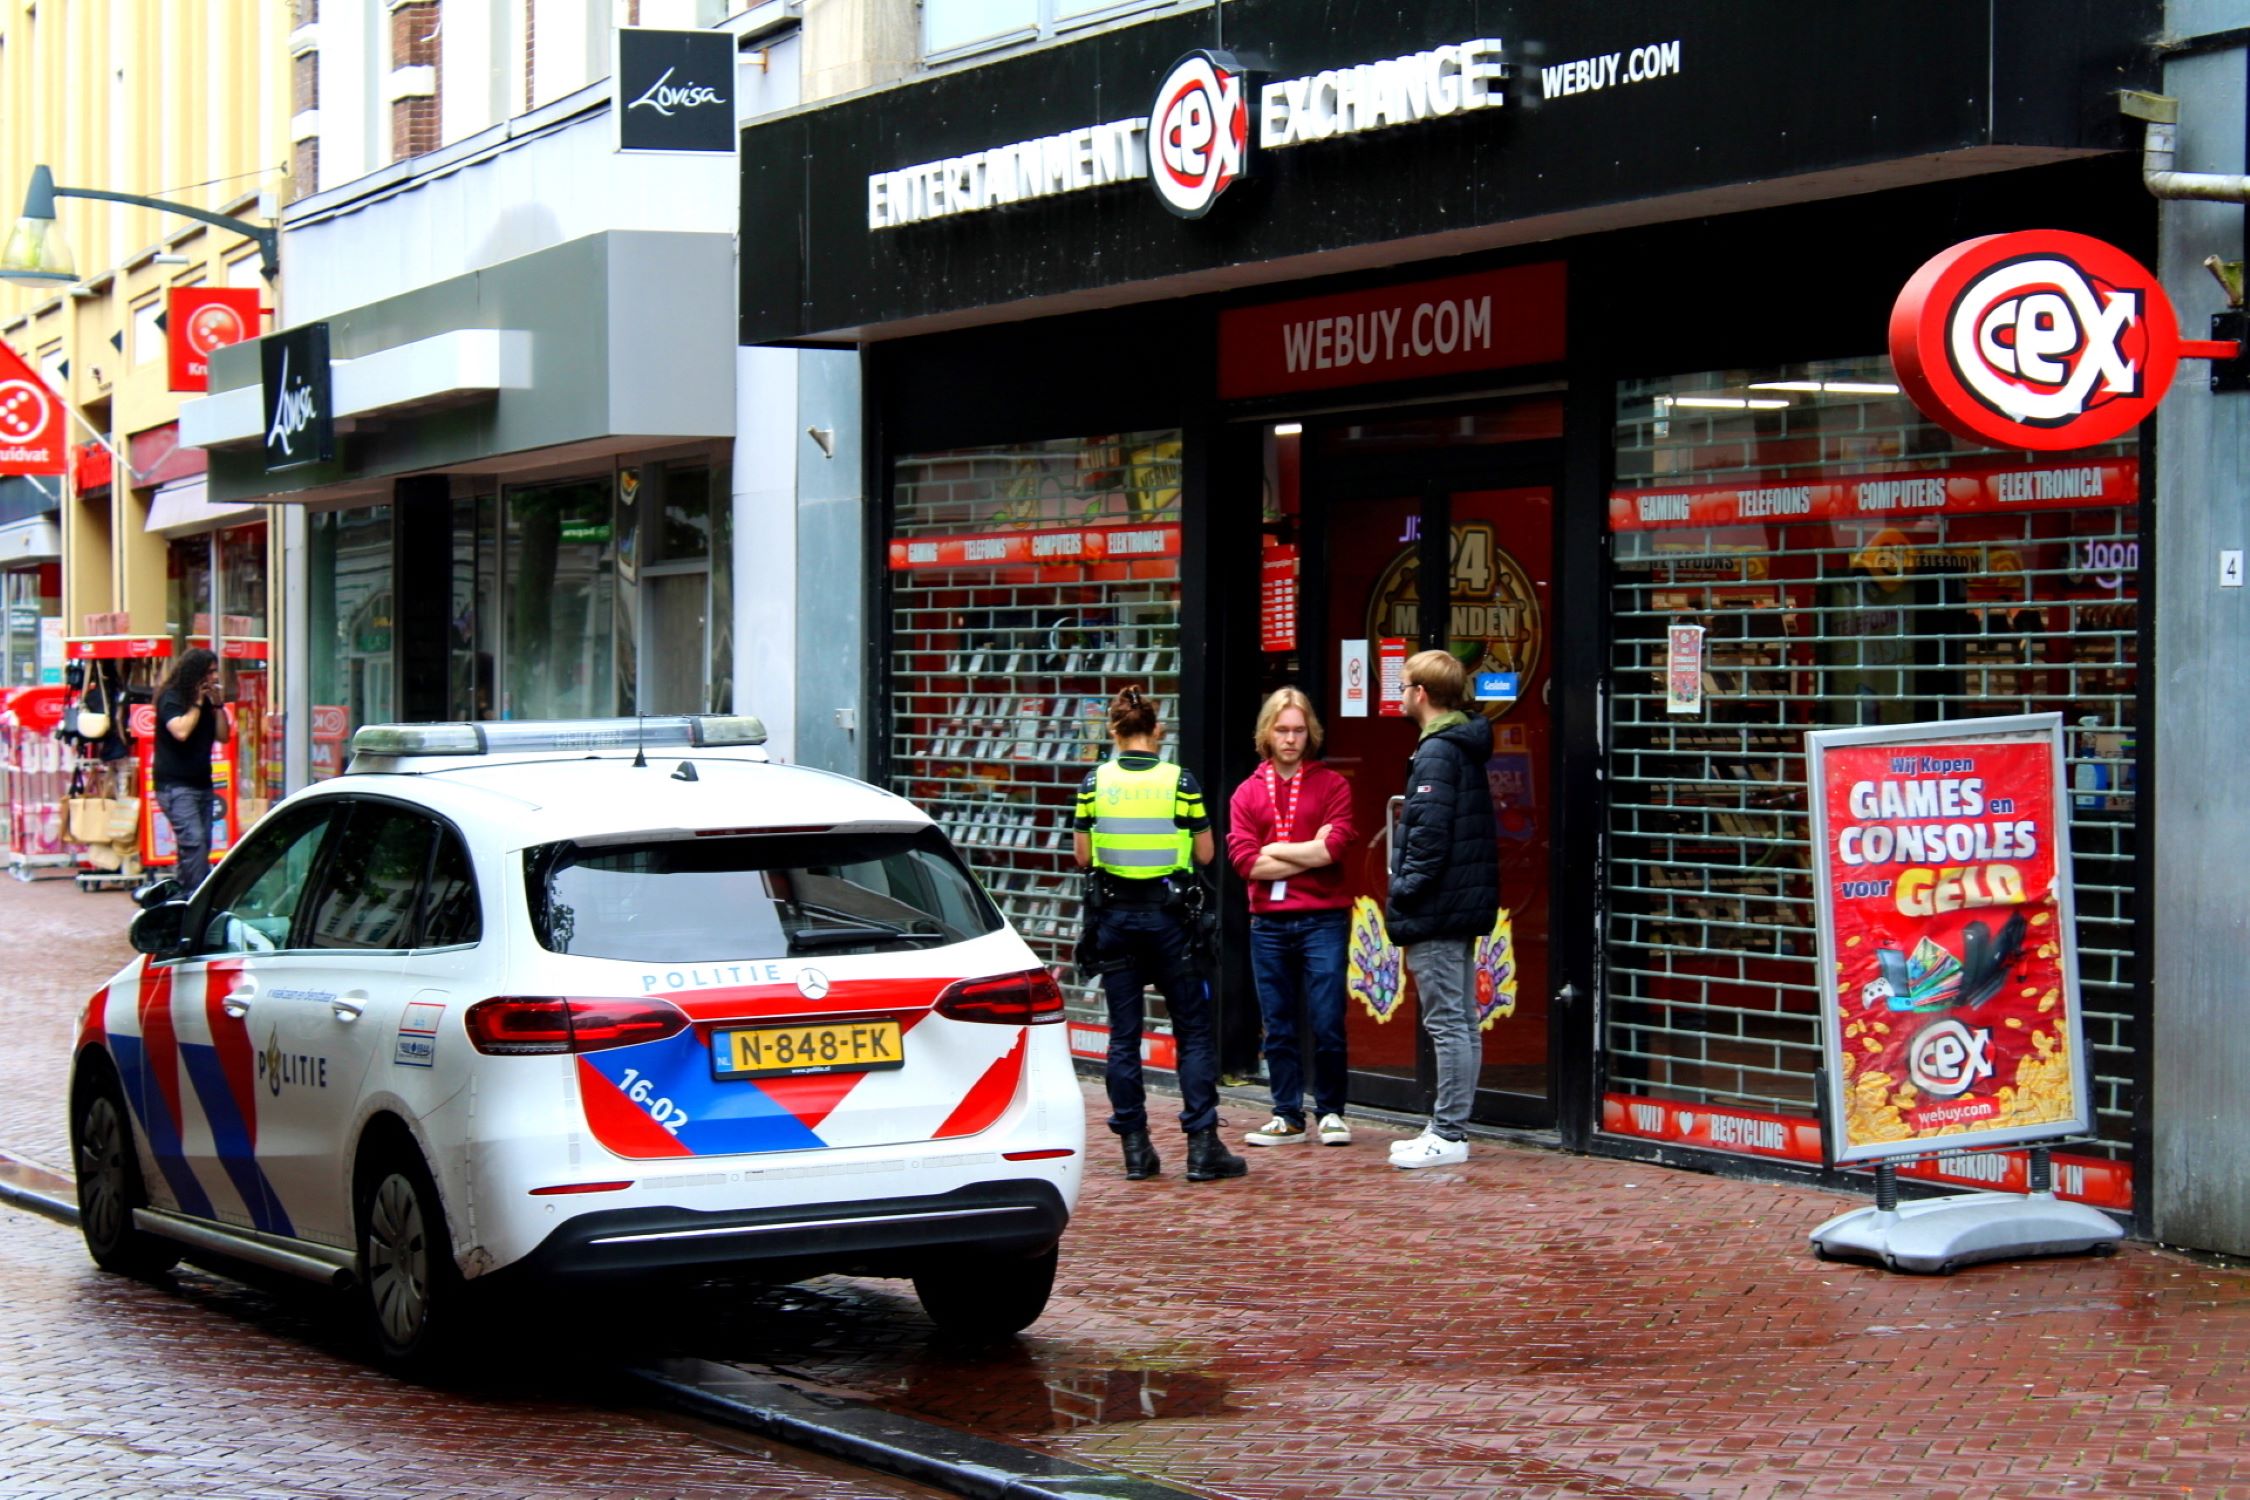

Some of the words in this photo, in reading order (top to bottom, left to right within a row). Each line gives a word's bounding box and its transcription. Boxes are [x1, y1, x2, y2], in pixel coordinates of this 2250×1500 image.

[628, 66, 727, 116] Lovisa
[1541, 40, 1681, 101] WEBUY.COM
[867, 117, 1149, 231] ENTERTAINMENT
[1260, 37, 1503, 150] EXCHANGE
[1283, 295, 1493, 374] WEBUY.COM
[267, 345, 318, 456] Lovisa
[1639, 494, 1689, 522] GAMING
[1737, 486, 1811, 516] TELEFOONS
[1857, 476, 1946, 512] COMPUTERS
[1998, 466, 2104, 502] ELEKTRONICA
[2226, 557, 2237, 580] 4
[1395, 604, 1516, 637] MNDEN
[1891, 757, 1917, 775] Wij
[1921, 757, 1973, 775] Kopen
[1849, 778, 1984, 820] GAMES
[1990, 798, 2013, 814] en
[1838, 820, 2037, 866] CONSOLES
[1842, 880, 1890, 898] voor
[1895, 864, 2027, 918] GELD
[642, 964, 782, 992] POLITIE
[717, 1057, 731, 1066] NL
[741, 1028, 890, 1065] N-848-FK
[619, 1067, 689, 1136] 16-02
[1918, 1103, 1992, 1124] webuy.com
[1637, 1103, 1663, 1132] WIJ
[1710, 1113, 1786, 1151] RECYCLING
[1937, 1147, 2009, 1182] VERKOOP
[2065, 1164, 2083, 1195] IN
